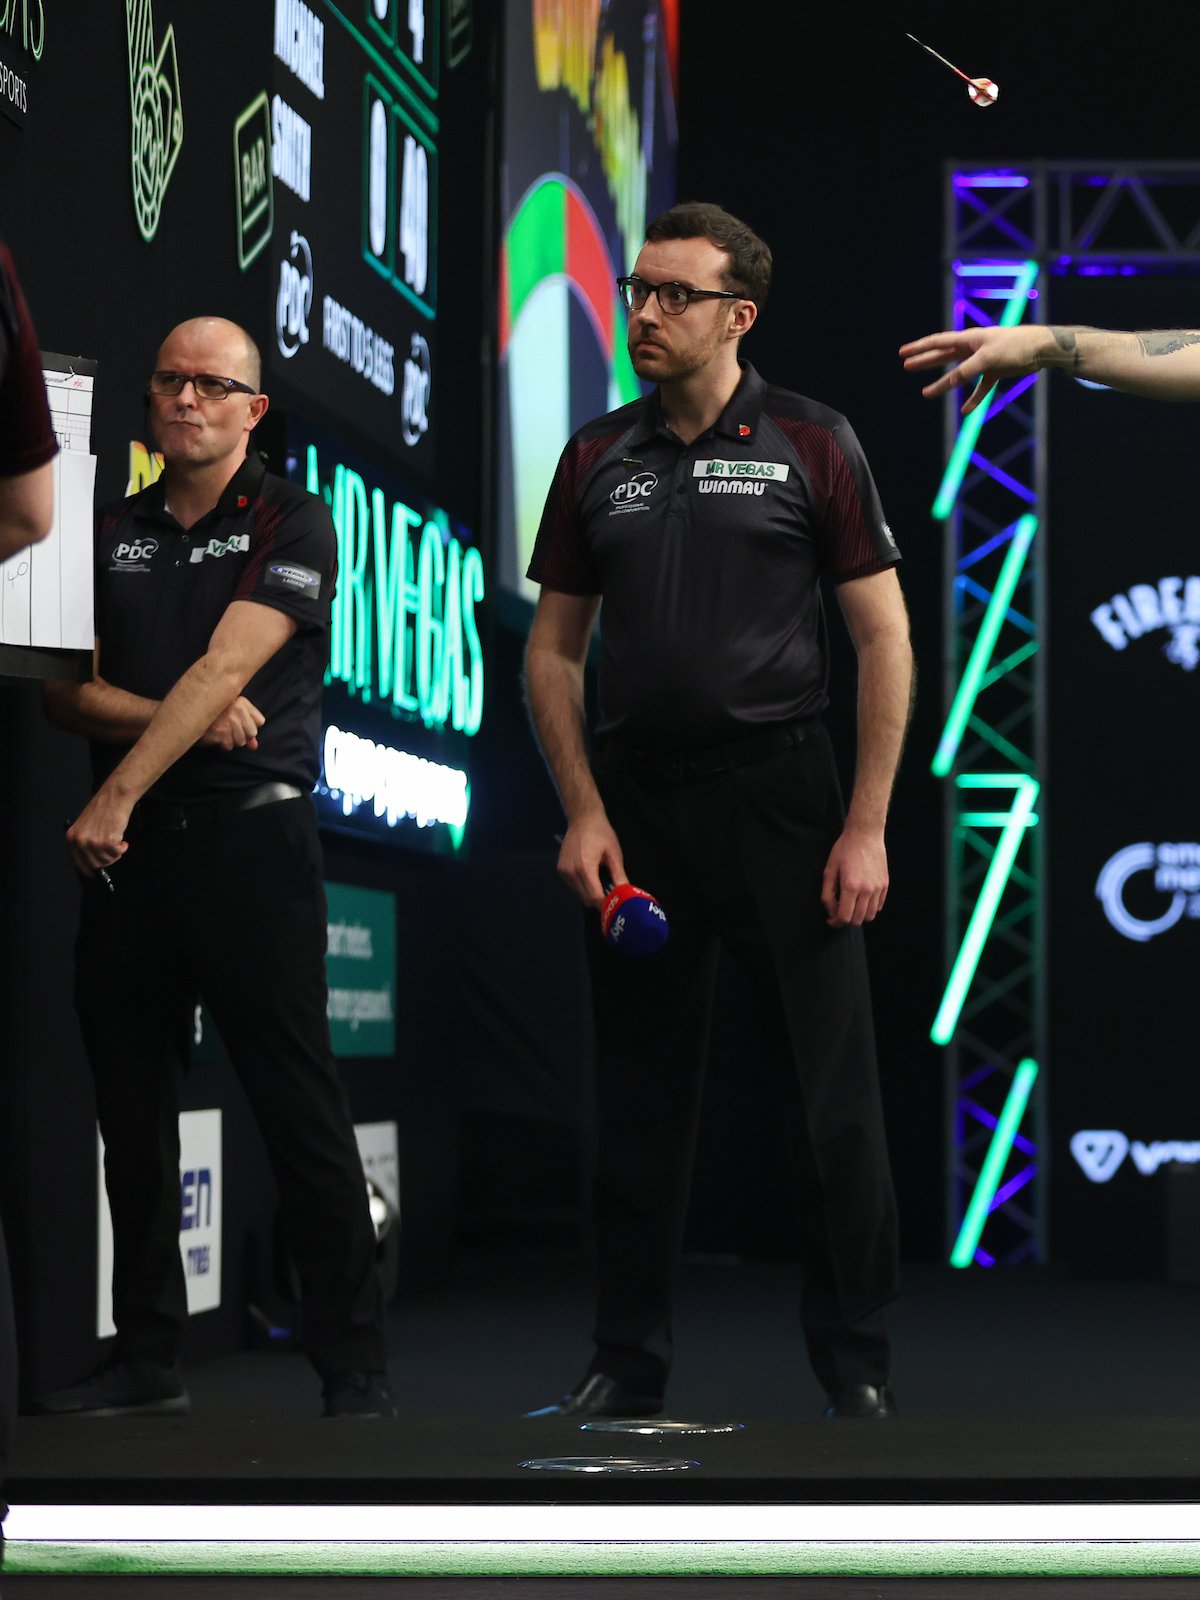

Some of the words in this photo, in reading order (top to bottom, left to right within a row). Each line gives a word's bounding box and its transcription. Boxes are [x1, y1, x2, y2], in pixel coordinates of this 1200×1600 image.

[705, 461, 724, 475] MR
[727, 463, 775, 477] VEGAS
[615, 480, 654, 499] PDC
[698, 480, 766, 496] WINMAU
[116, 542, 154, 560] PDC
[372, 486, 485, 736] VEGAS
